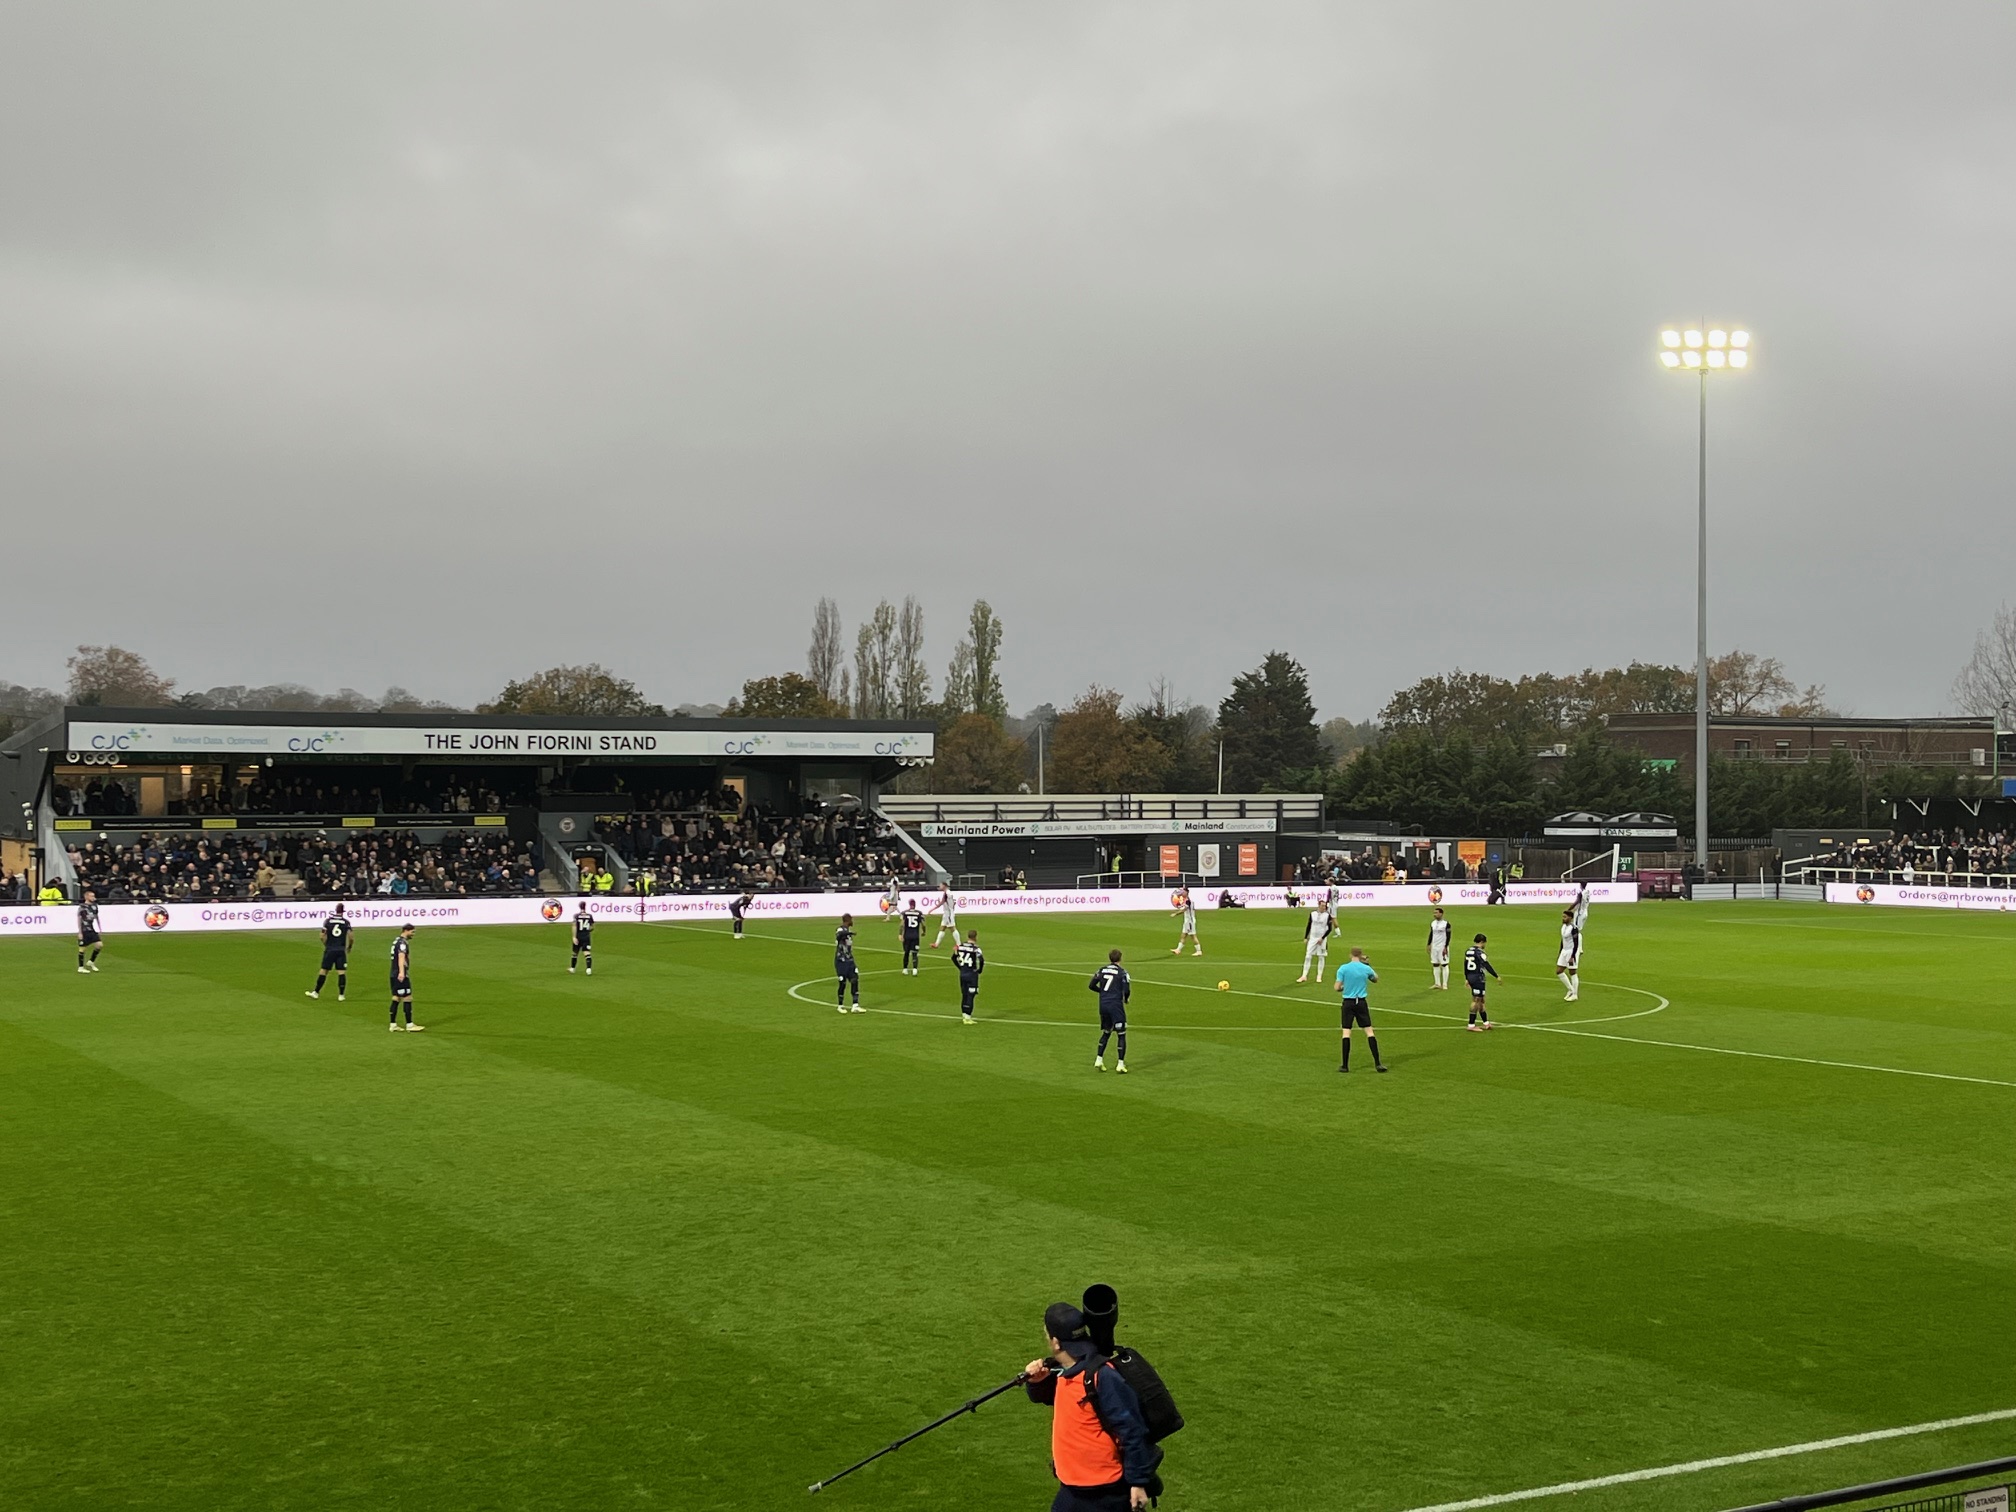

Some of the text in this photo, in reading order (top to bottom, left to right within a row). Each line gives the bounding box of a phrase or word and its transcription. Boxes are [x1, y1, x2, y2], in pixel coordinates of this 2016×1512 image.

[91, 735, 130, 750] CJC
[288, 737, 325, 752] CJC
[424, 734, 657, 750] THE JOHN FIORINI STAND
[724, 741, 755, 755] CJC
[875, 742, 903, 755] CJC
[936, 825, 1026, 835] Mainland Power
[1184, 822, 1224, 830] Mainland
[202, 906, 459, 922] Orders@mrbrownseshproduce.com
[590, 900, 810, 916] Orders@mrbrownsfresoduce.com
[577, 919, 590, 931] 14
[906, 915, 919, 928] 15
[331, 924, 342, 937] 6
[957, 951, 973, 967] 34
[1103, 974, 1114, 992] 7
[1965, 1494, 2006, 1509] NO STANDING
